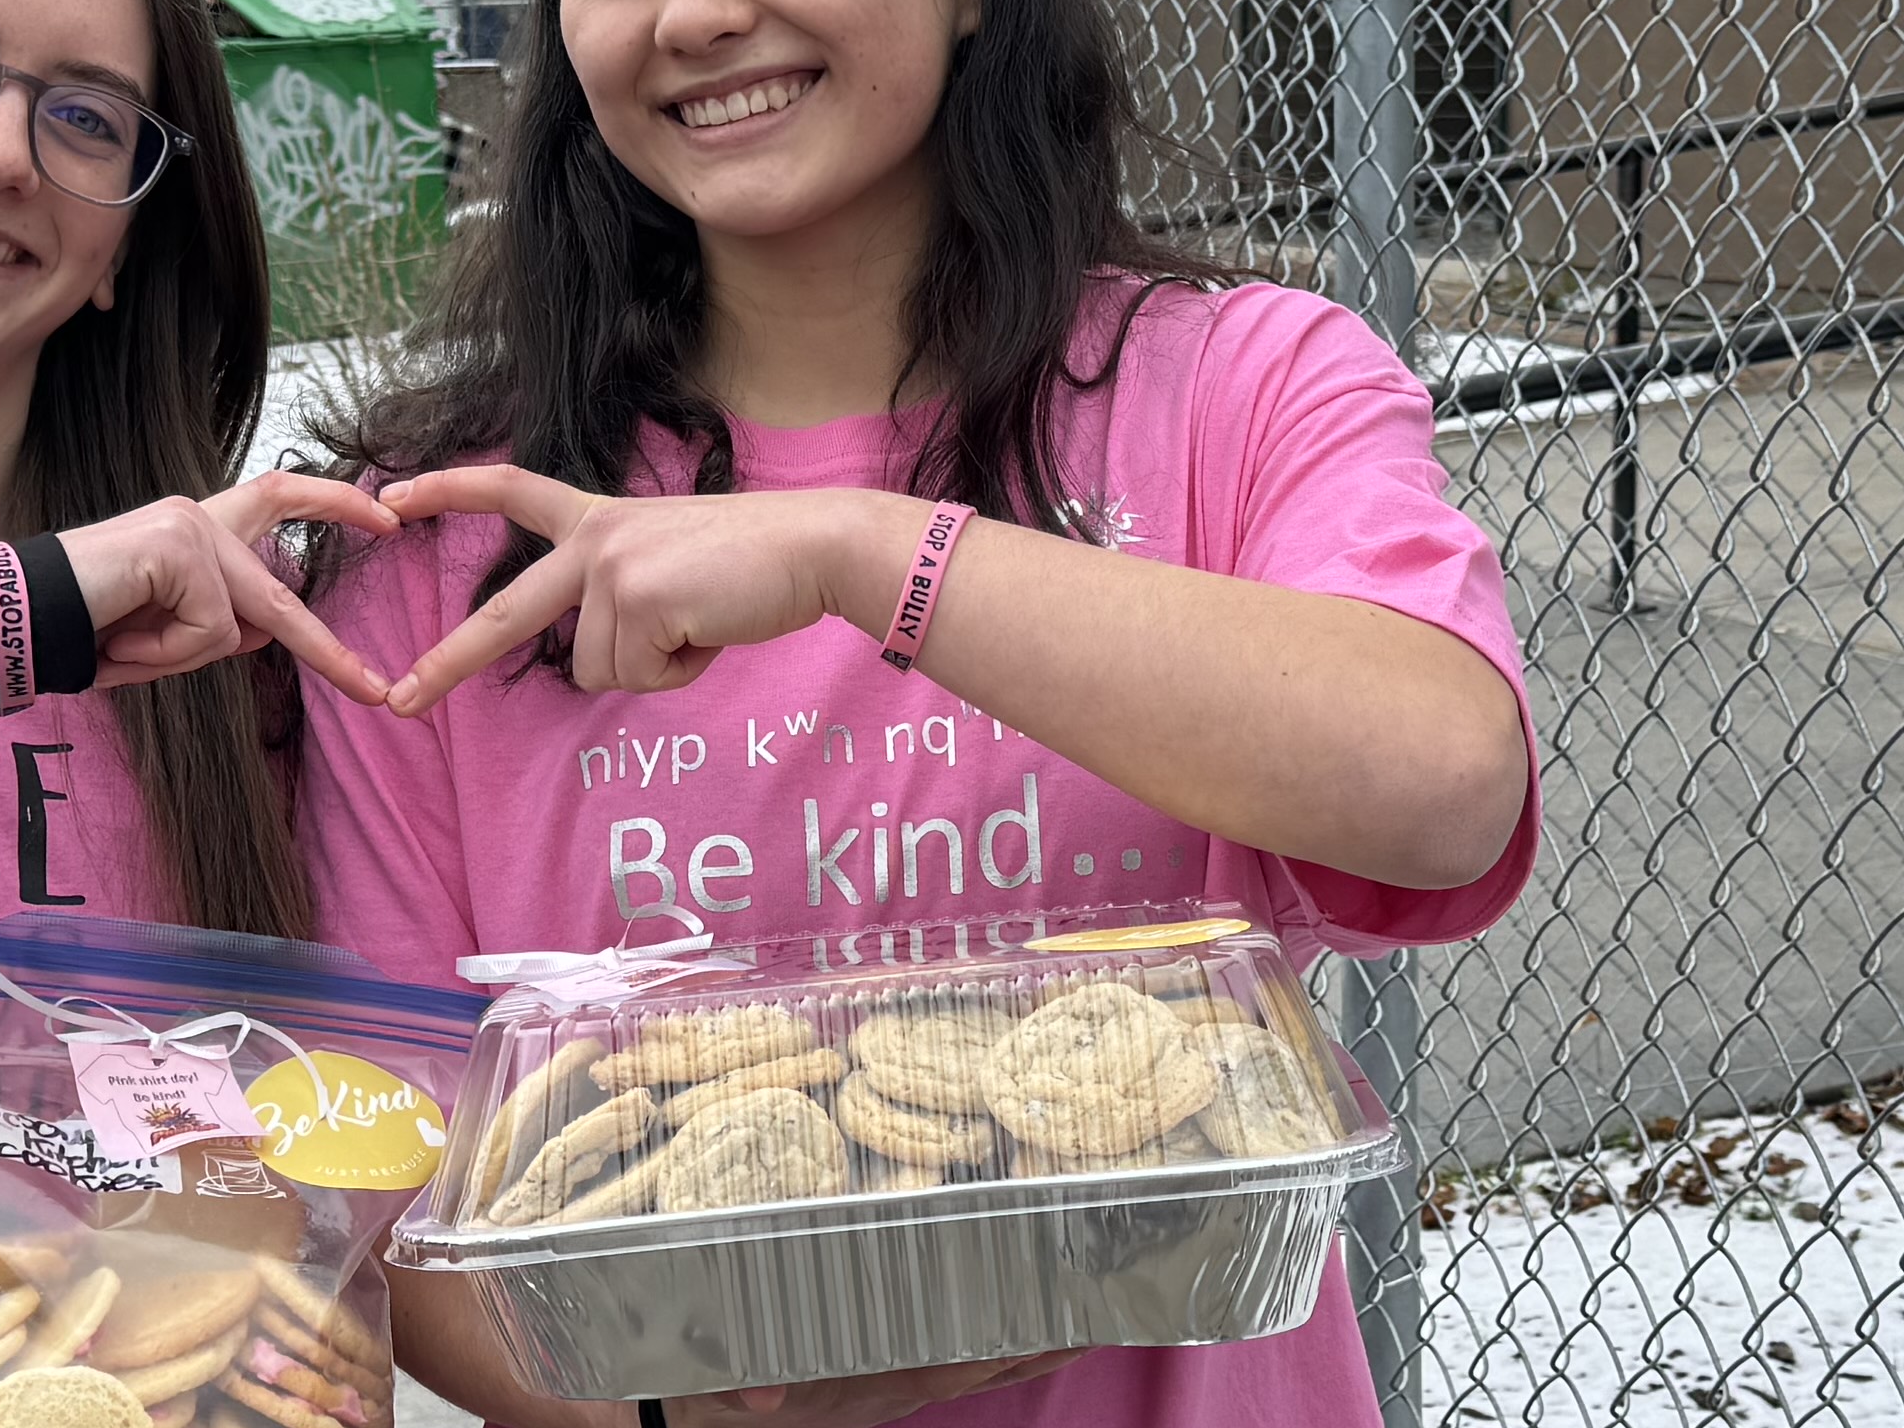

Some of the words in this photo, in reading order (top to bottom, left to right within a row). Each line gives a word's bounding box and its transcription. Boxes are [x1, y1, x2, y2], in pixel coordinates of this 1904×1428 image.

[925, 513, 957, 552] STOP
[919, 554, 937, 568] A
[897, 574, 932, 640] BULLY
[578, 727, 707, 790] niyp
[609, 817, 754, 920] Be
[108, 1075, 136, 1087] Pink
[139, 1074, 167, 1086] shirt
[252, 1102, 318, 1156] Be
[322, 1080, 420, 1132] Kind
[316, 1165, 360, 1177] JUST
[370, 1150, 427, 1178] BECAUSE
